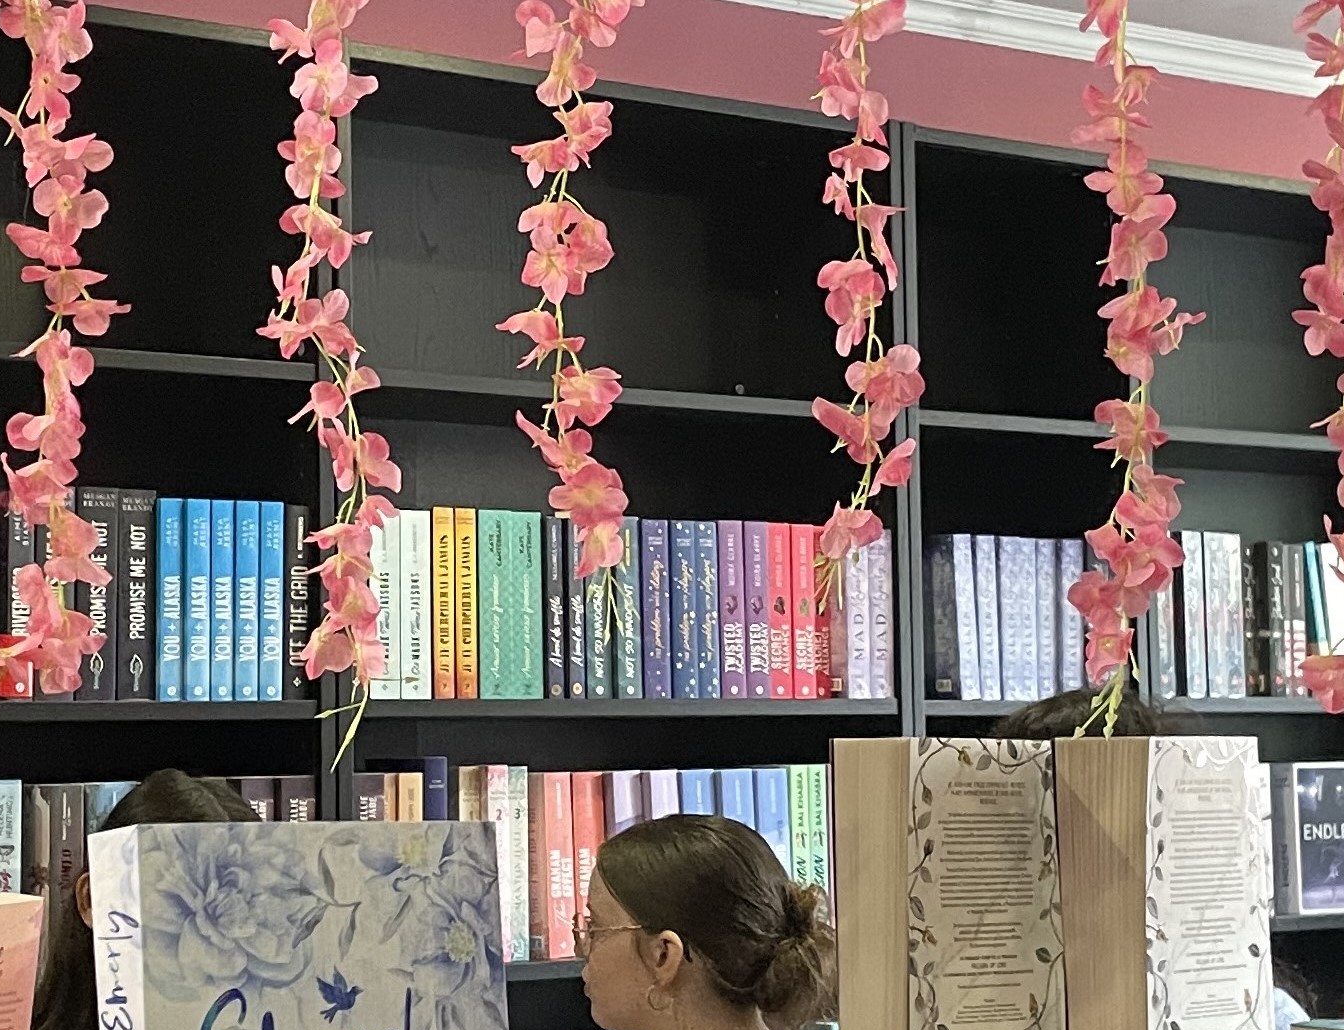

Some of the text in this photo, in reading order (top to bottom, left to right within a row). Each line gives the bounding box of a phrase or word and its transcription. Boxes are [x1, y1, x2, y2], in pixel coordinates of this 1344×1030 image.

[129, 525, 146, 640] PROMISE ME NOT
[291, 566, 308, 600] GRID
[164, 576, 180, 662] YOU ALASKA
[191, 576, 207, 662] YOU ALASKA
[215, 576, 231, 662] YOU ALASKA
[239, 577, 256, 662] YOU ALASKA
[264, 577, 280, 662] YOU ALASKA
[290, 605, 307, 632] THE
[595, 642, 604, 678] NOT SO
[625, 642, 635, 678] NOT SO
[724, 624, 737, 673] TWISTED
[750, 624, 764, 673] TWISTED
[771, 629, 782, 669] SECRET
[796, 629, 806, 671] SECRET
[496, 808, 503, 820] 2
[515, 808, 521, 820] 3
[550, 850, 562, 898] GRAHAM
